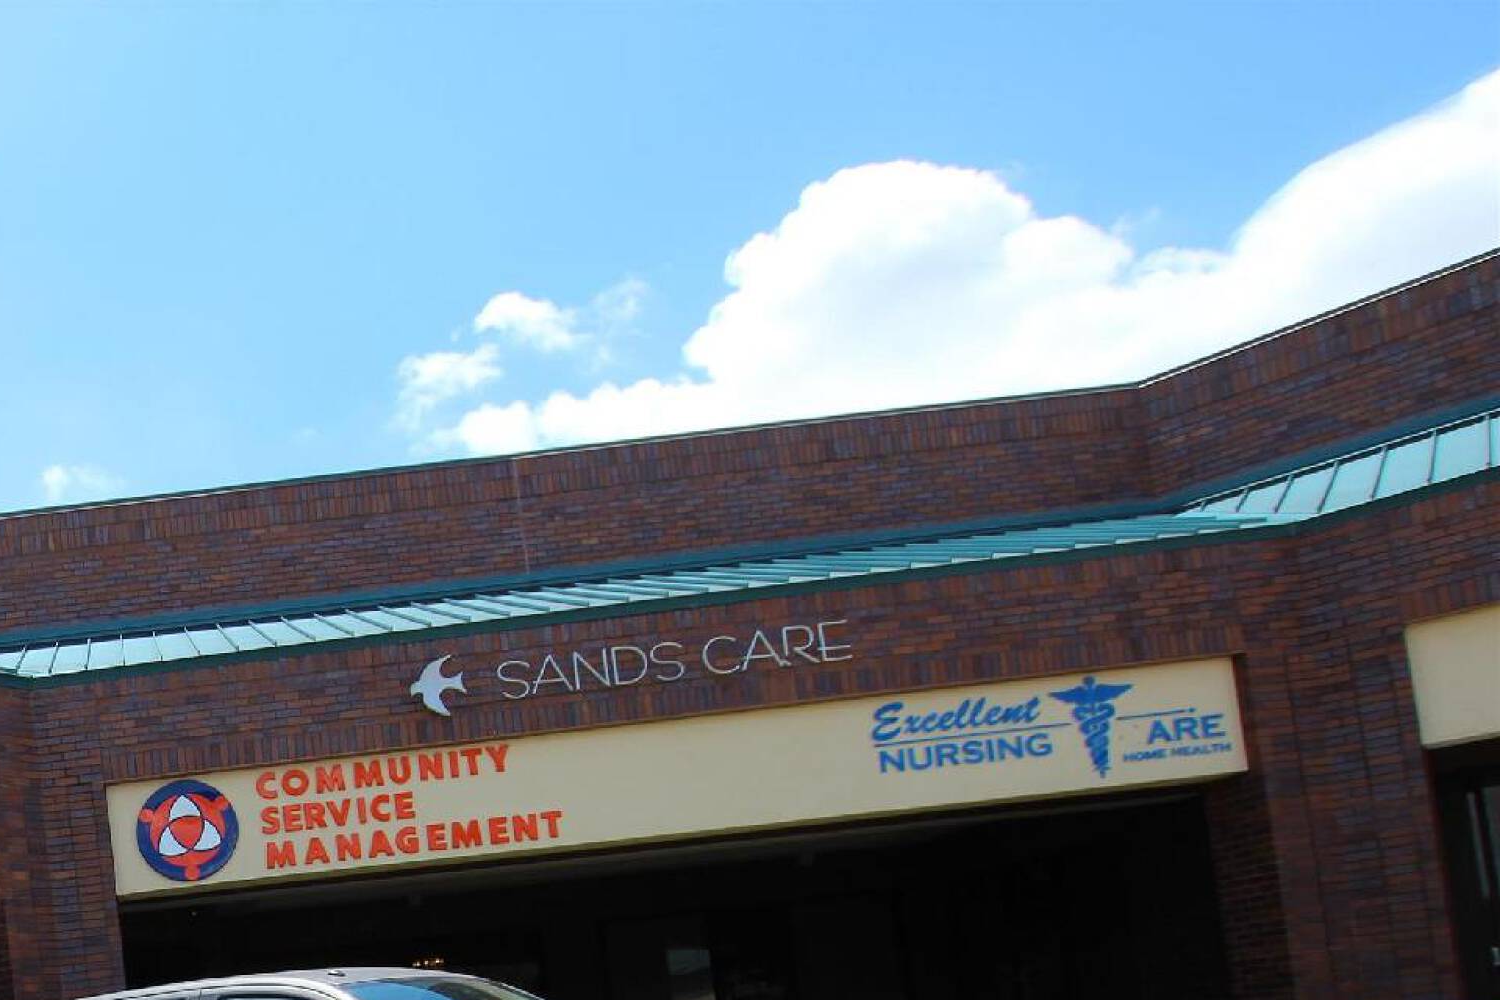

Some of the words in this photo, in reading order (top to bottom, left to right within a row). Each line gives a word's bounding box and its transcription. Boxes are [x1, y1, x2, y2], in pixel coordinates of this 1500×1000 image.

[497, 641, 685, 700] SANDS
[702, 619, 853, 675] CARE
[871, 697, 1041, 744] Excellent
[255, 744, 509, 800] COMMUNITY
[878, 732, 1053, 774] NURSING
[1123, 748, 1168, 763] HOME
[1171, 742, 1232, 758] HEALTH
[260, 791, 416, 836] SERVICE
[266, 810, 563, 870] MANAGEMENT
